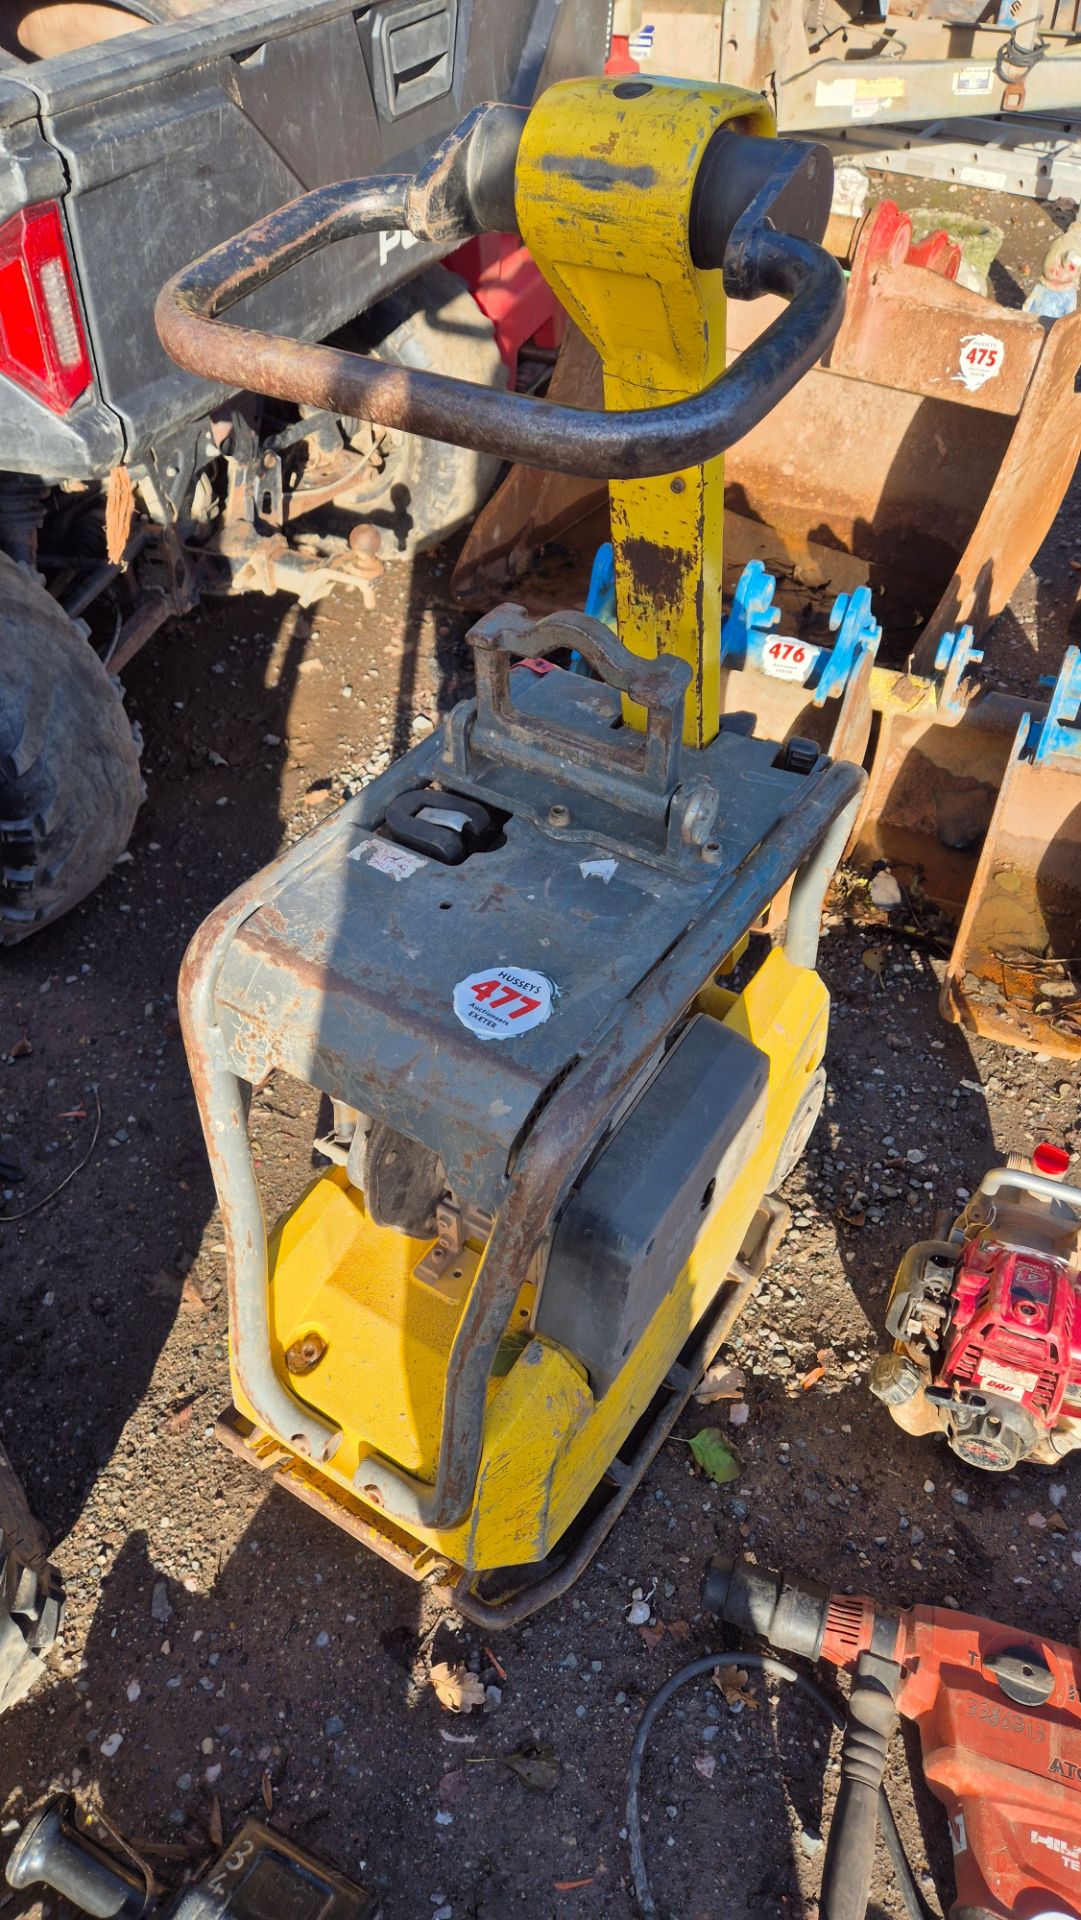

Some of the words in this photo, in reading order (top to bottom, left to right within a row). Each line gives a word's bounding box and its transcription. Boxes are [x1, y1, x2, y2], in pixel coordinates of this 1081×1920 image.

[966, 347, 998, 367] 475
[768, 642, 806, 663] 476
[498, 970, 541, 994] HUSSEYS
[470, 979, 542, 1019] 477
[468, 1011, 498, 1029] EXETER
[469, 1002, 509, 1026] Auctioneers
